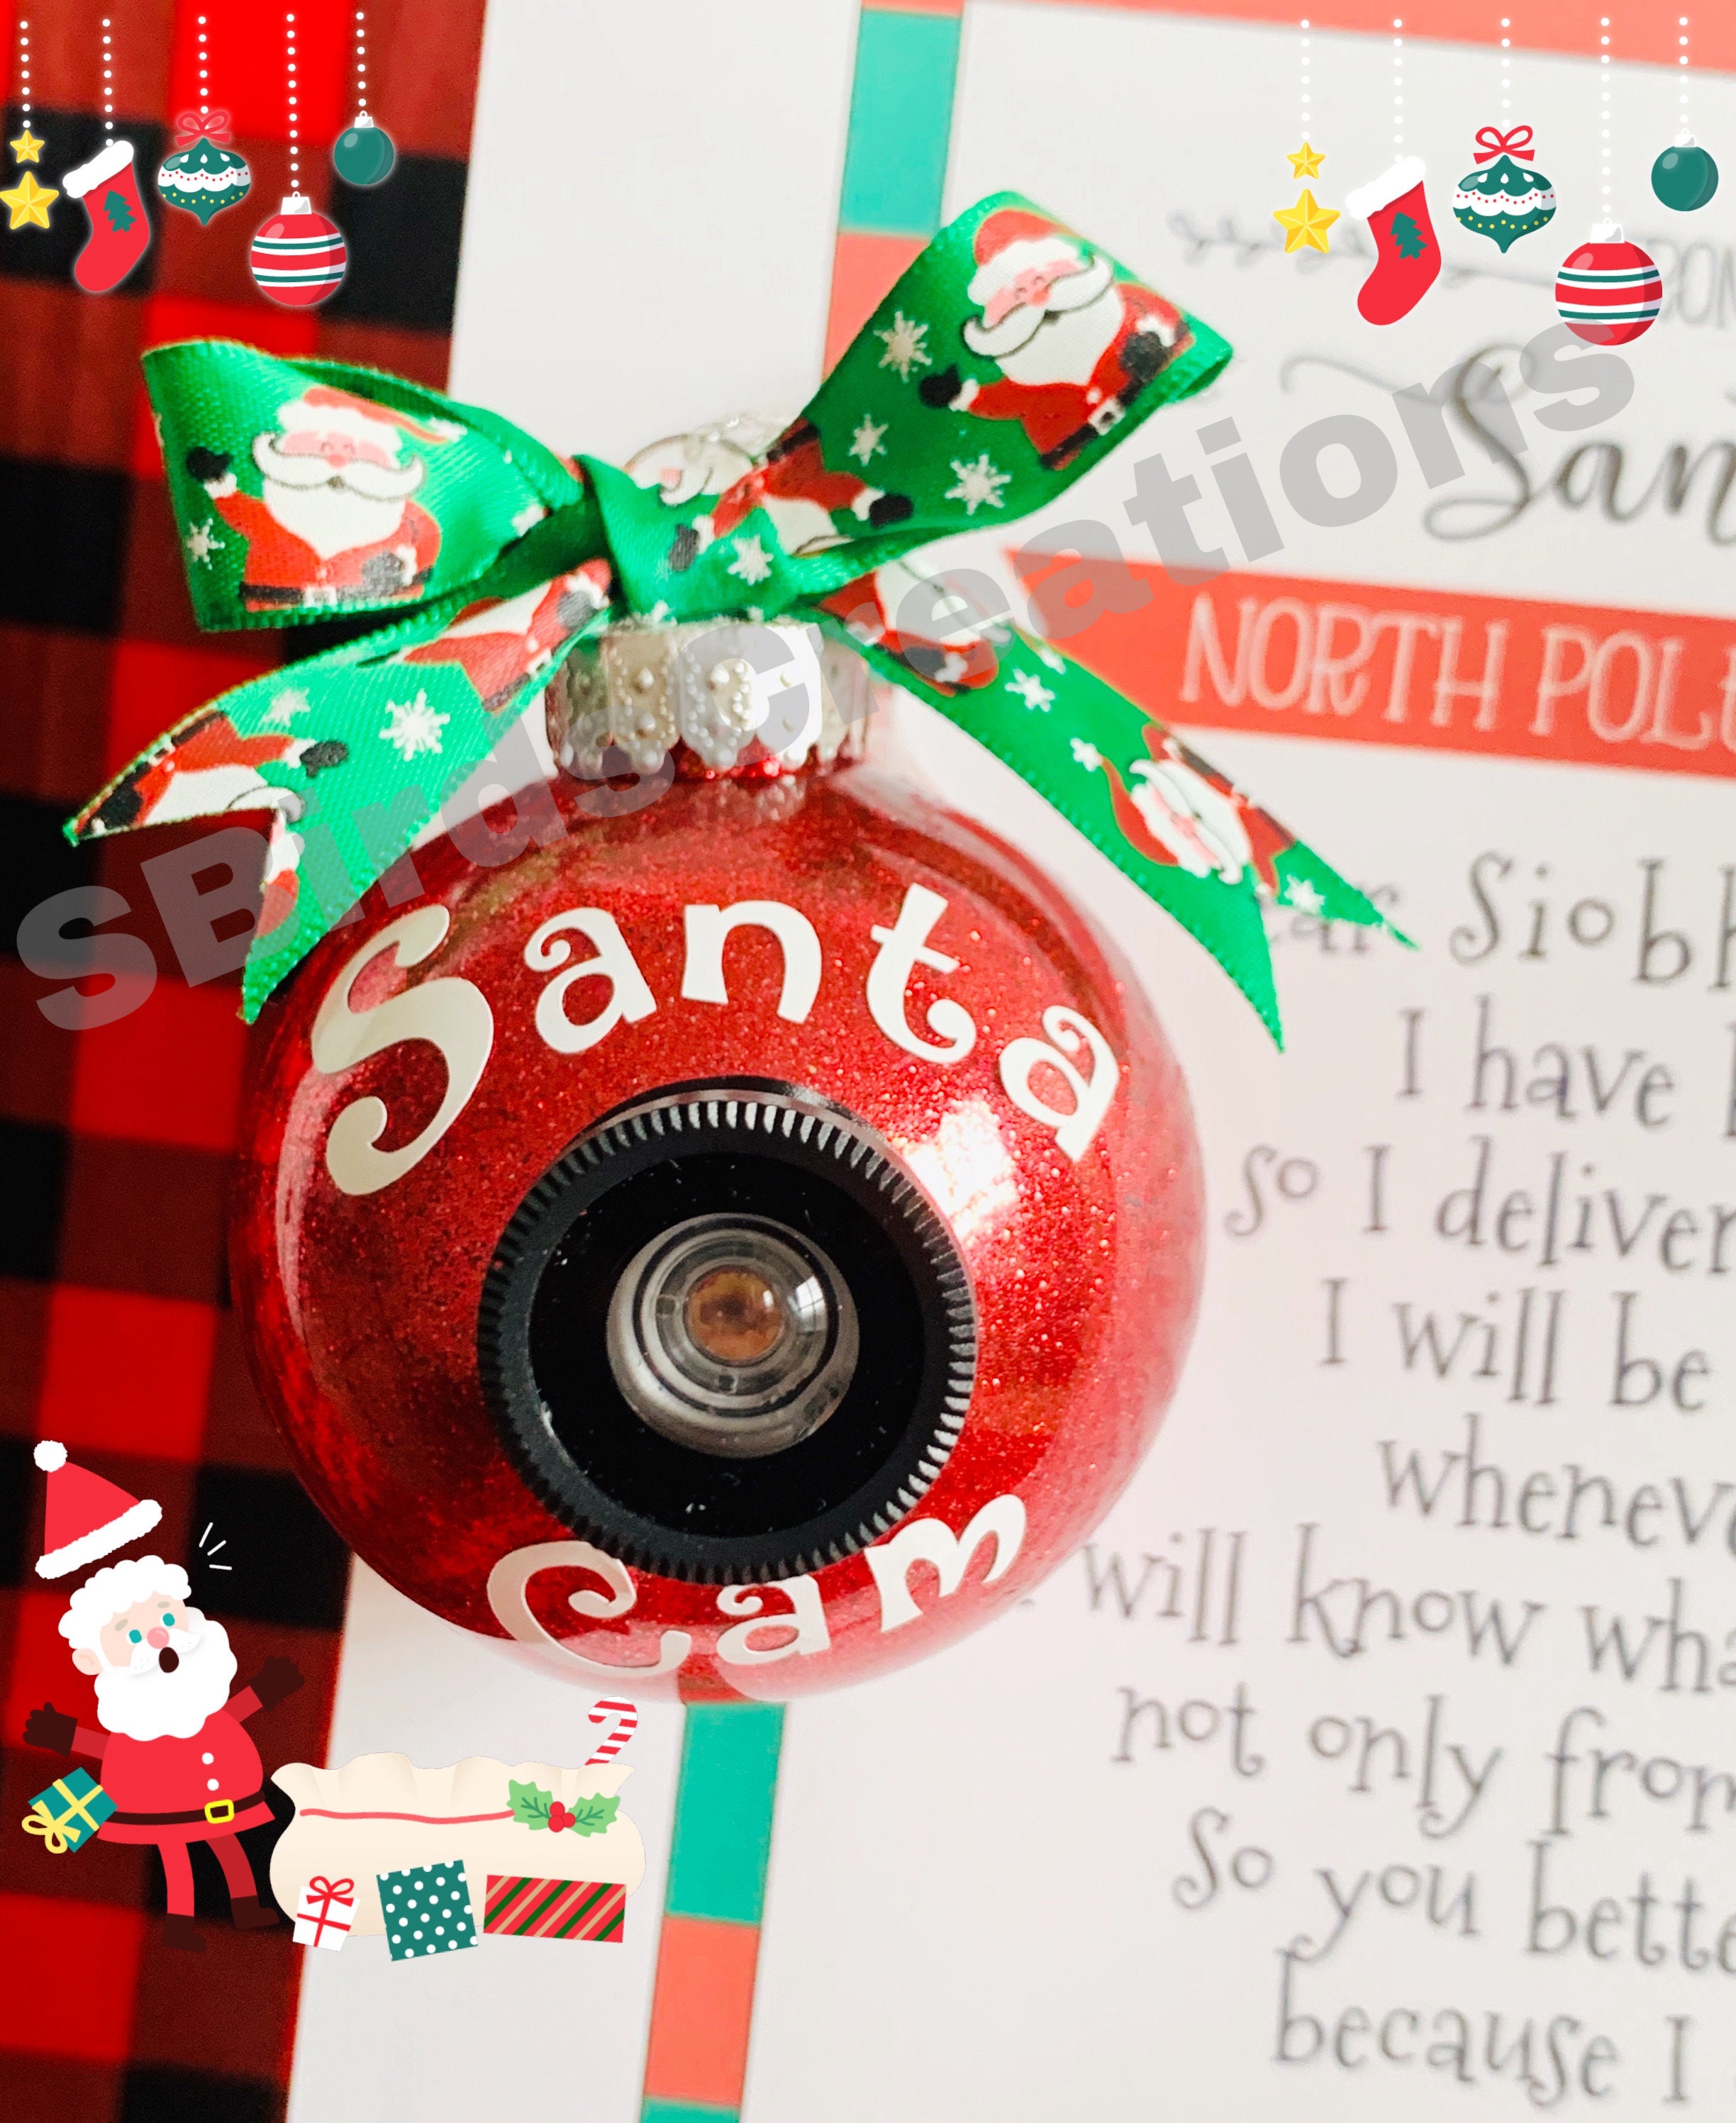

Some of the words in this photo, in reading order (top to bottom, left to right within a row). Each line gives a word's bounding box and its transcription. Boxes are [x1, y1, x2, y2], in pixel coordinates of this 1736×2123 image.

[1180, 590, 1512, 733] NORTH
[311, 883, 1120, 1196] Santa
[1397, 1007, 1424, 1100] I
[1464, 994, 1676, 1129] have
[1362, 1142, 1393, 1235] I
[1318, 1276, 1350, 1368] I
[1392, 1286, 1567, 1407] will
[1608, 1290, 1712, 1413] be
[487, 1493, 1027, 1678] Cam
[1080, 1527, 1248, 1646] will
[1285, 1522, 1549, 1666] know
[1111, 1681, 1266, 1778] not
[1308, 1693, 1504, 1840] only
[1172, 1805, 1274, 1911] So
[1285, 1861, 1479, 1963] you
[1272, 1948, 1621, 2108] because
[1662, 2014, 1693, 2104] I
